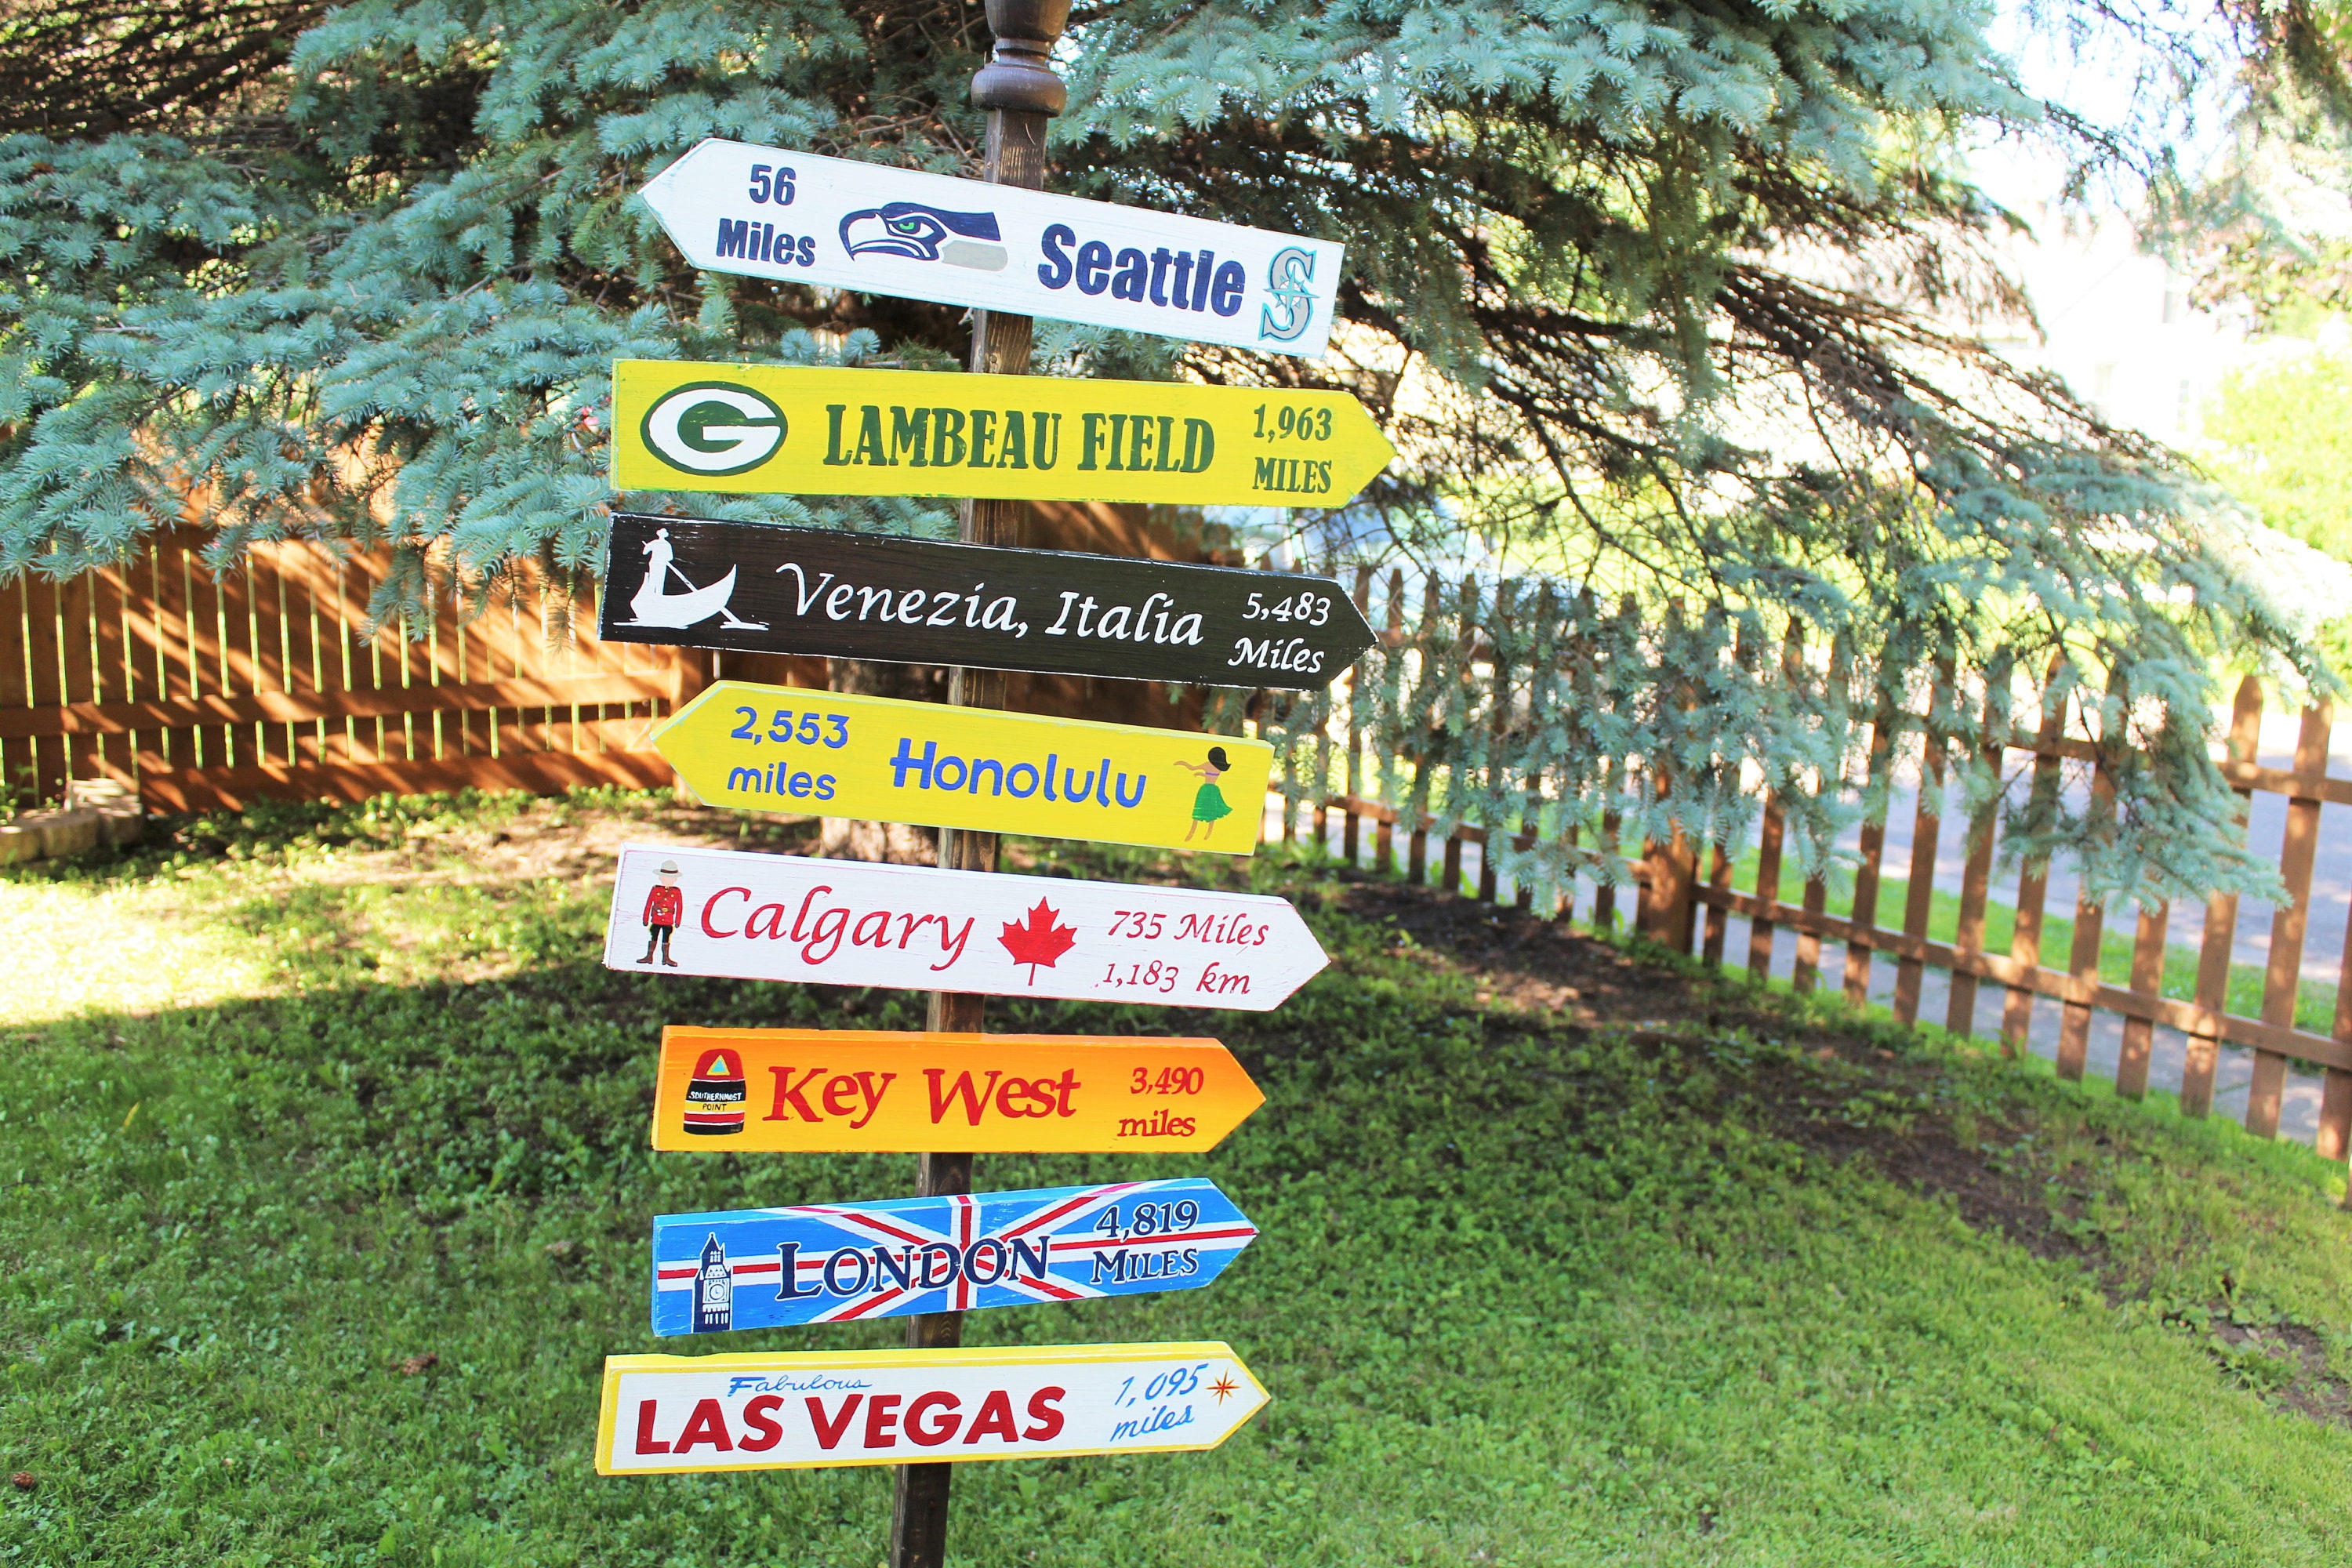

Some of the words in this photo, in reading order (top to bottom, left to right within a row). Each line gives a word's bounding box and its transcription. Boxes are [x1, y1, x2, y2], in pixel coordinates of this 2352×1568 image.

[749, 164, 795, 206] 56
[717, 218, 815, 267] Miles
[1037, 223, 1246, 317] Seattle
[648, 389, 781, 470] G
[823, 404, 1063, 470] LAMBEAU
[1077, 413, 1215, 474] FIELD
[1253, 404, 1332, 443] 1,963
[1253, 457, 1332, 495] MILES
[776, 562, 1029, 639] Venezia,
[1045, 591, 1203, 646] Italia
[1242, 591, 1331, 626] 5,483
[1227, 637, 1325, 674] Miles
[730, 707, 849, 750] 2,553
[728, 761, 836, 801] miles
[889, 738, 1147, 808] Honolulu
[700, 885, 975, 972] Calgary
[1109, 911, 1167, 940] 735
[1174, 913, 1269, 946] Miles
[1102, 960, 1178, 993] 1,183
[1196, 962, 1251, 996] km
[689, 1091, 742, 1102] SOUTHERNMOST
[763, 1065, 895, 1129] Key
[923, 1067, 1081, 1127] West
[1131, 1066, 1204, 1097] 3,490
[702, 1103, 728, 1112] POINT
[1116, 1109, 1196, 1137] miles
[1095, 1200, 1199, 1243] 4,819
[775, 1236, 1050, 1301] LONDON
[1090, 1248, 1198, 1287] MILES
[728, 1375, 872, 1396] Fabulous
[1116, 1364, 1209, 1409] 1,095
[635, 1395, 784, 1455] LAS
[804, 1387, 1066, 1450] VEGAS
[1111, 1404, 1194, 1442] miles
